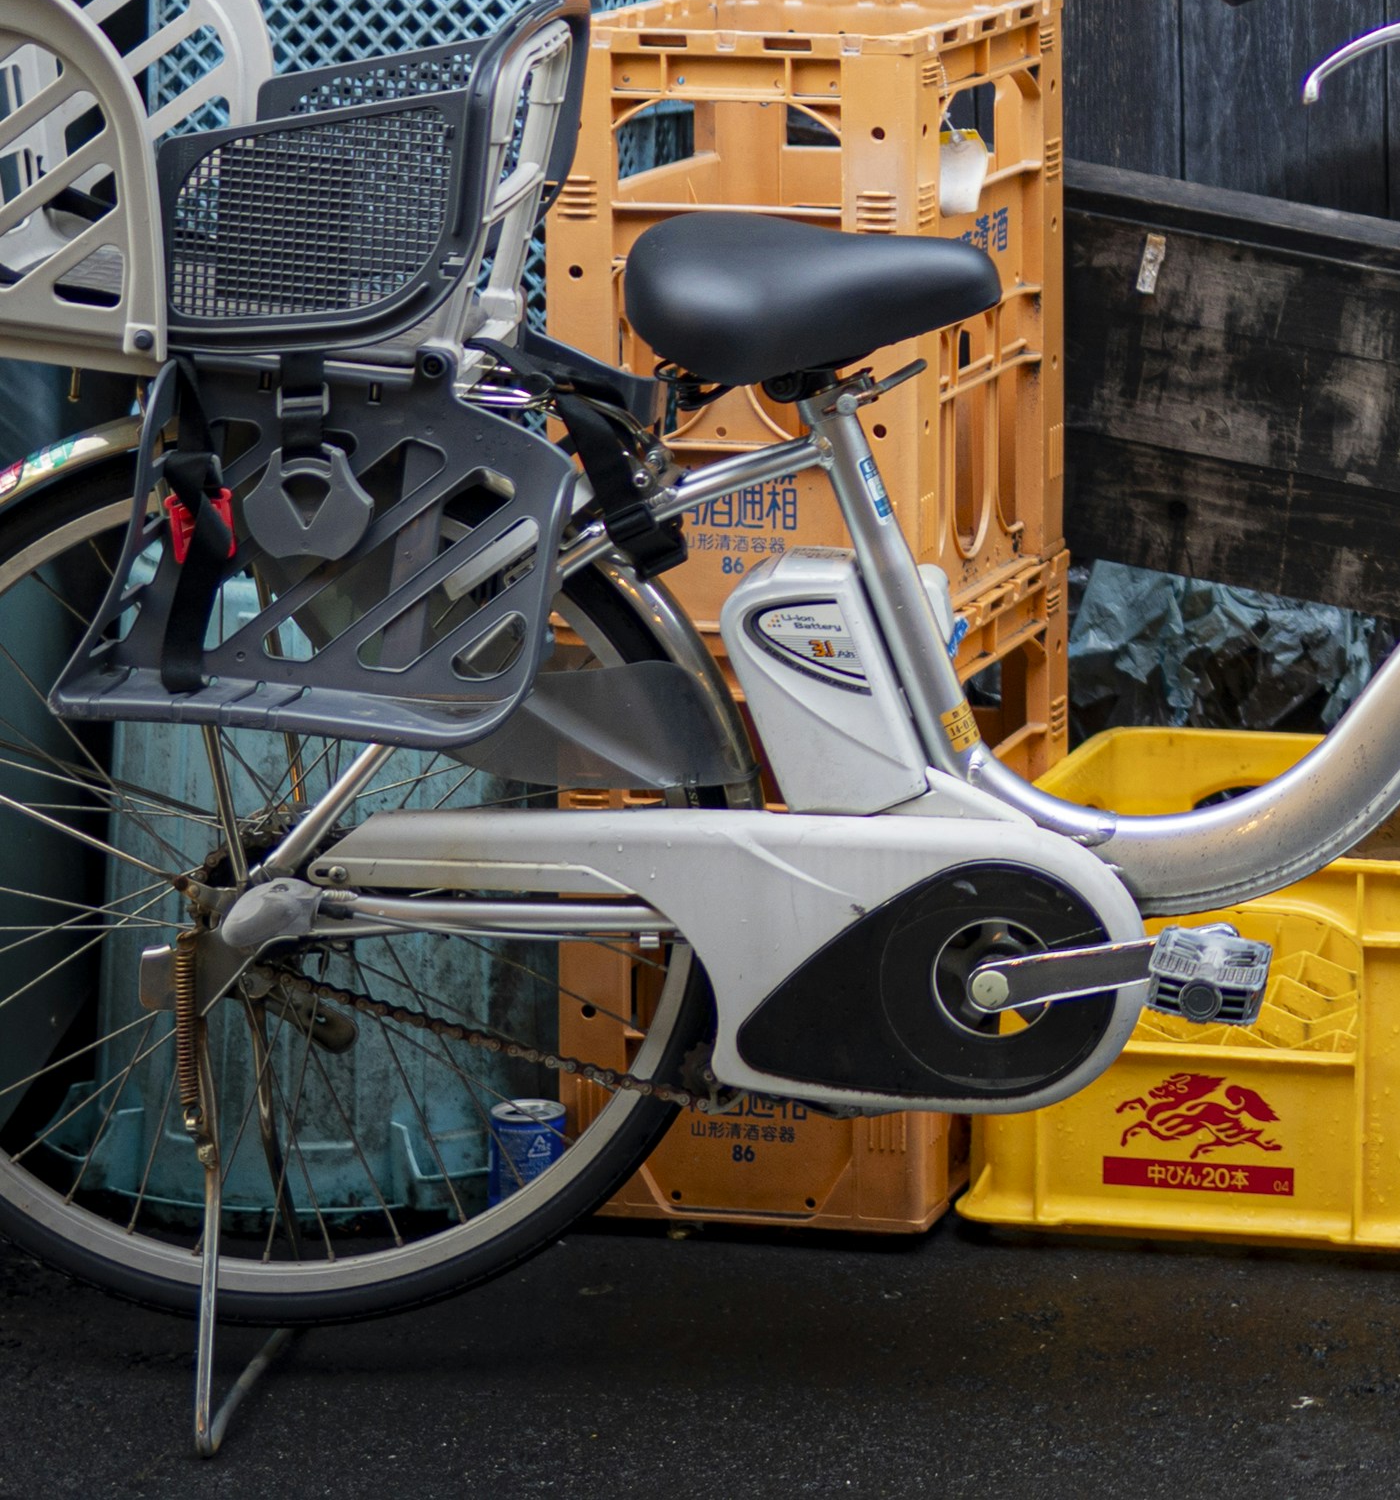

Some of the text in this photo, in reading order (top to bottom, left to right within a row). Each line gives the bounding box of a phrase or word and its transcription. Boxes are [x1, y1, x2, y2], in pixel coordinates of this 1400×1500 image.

[721, 556, 745, 574] 86
[781, 613, 816, 623] Li-ion
[794, 621, 842, 632] Battery
[691, 1120, 796, 1143] 山形清酒容器
[731, 1144, 756, 1163] 86
[1147, 1163, 1290, 1192] 中びん20本 04
